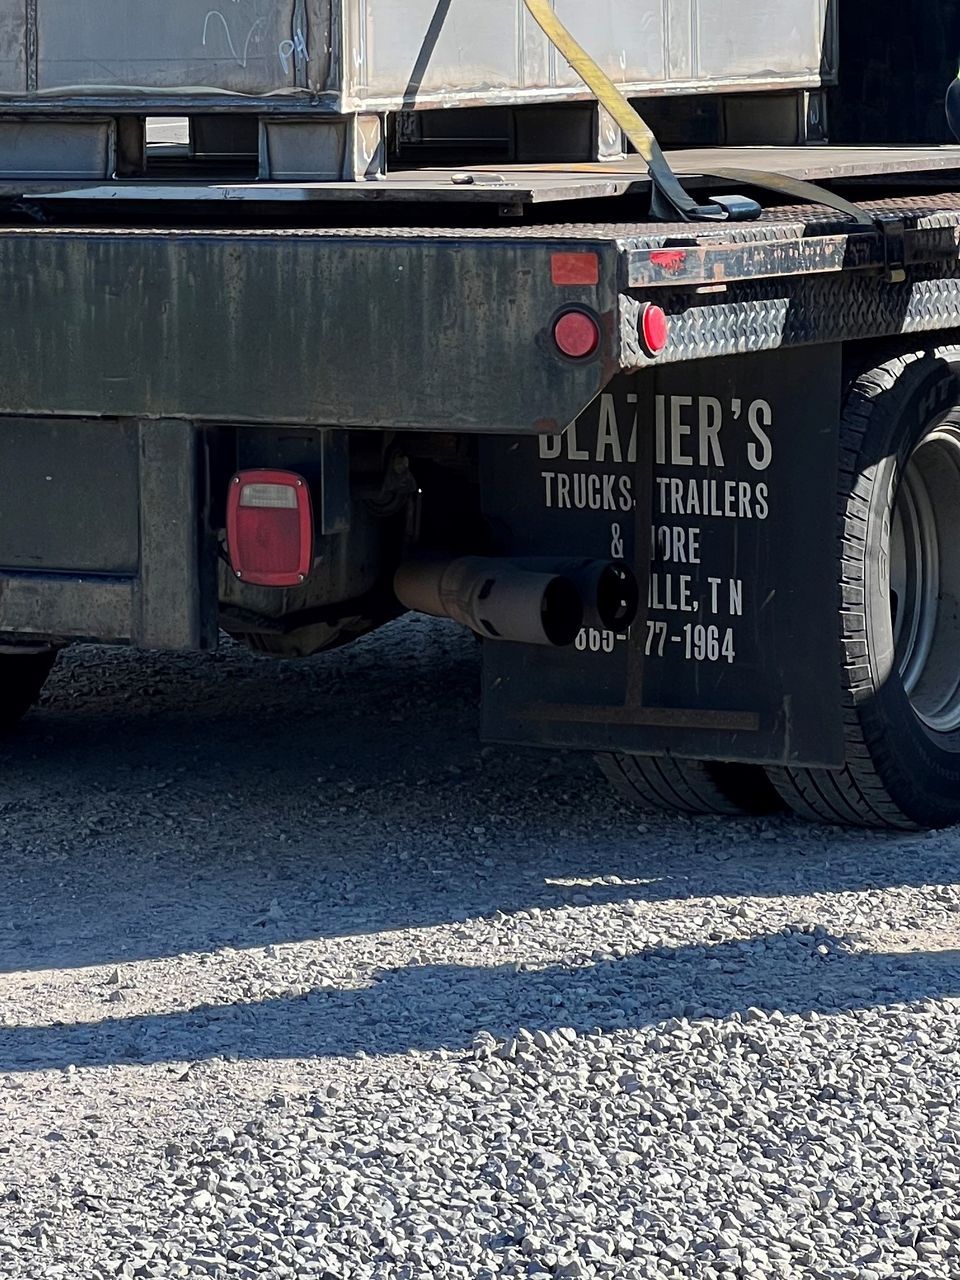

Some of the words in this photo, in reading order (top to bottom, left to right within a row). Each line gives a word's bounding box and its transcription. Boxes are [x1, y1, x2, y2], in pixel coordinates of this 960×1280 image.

[655, 477, 770, 520] TRAILERS
[610, 522, 625, 559] &
[650, 524, 702, 564] ORE
[574, 619, 737, 664] 865-77-1964
